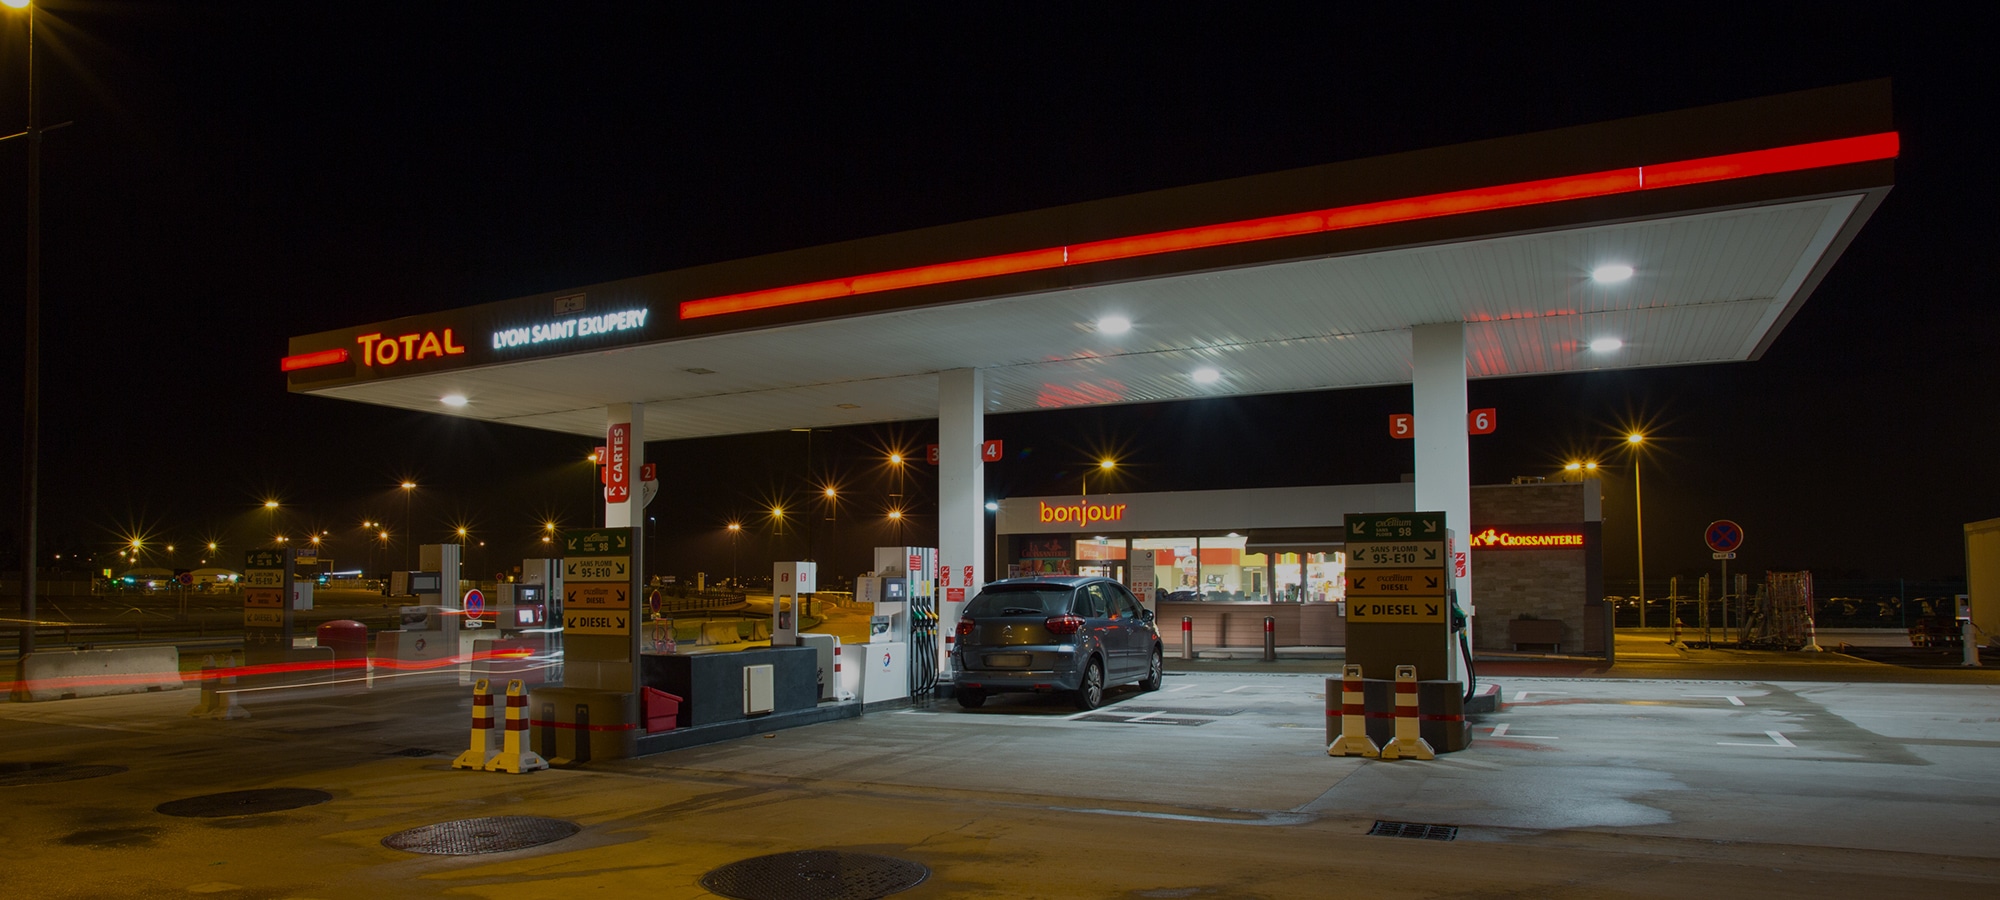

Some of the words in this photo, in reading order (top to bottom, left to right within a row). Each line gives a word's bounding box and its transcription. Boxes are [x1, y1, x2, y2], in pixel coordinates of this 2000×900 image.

[493, 327, 530, 349] LYON
[531, 319, 577, 343] SAINT
[577, 308, 648, 336] EXUPERY
[357, 328, 465, 367] TOTAL
[1396, 418, 1408, 434] 5
[1476, 413, 1488, 430] 6
[598, 450, 605, 462] 7
[613, 428, 624, 482] CARTES
[931, 448, 939, 462] 3
[986, 443, 997, 458] 4
[644, 467, 652, 479] 2
[1040, 499, 1127, 528] bonjour
[1398, 527, 1412, 537] 98
[1500, 532, 1584, 546] CROISSANTERIE
[598, 543, 609, 552] 98
[1392, 545, 1419, 553] PLOMB
[1373, 553, 1416, 564] 95-E10
[581, 568, 611, 577] 95-E10
[1372, 605, 1418, 615] DIESEL
[580, 617, 611, 628] DIESEL
